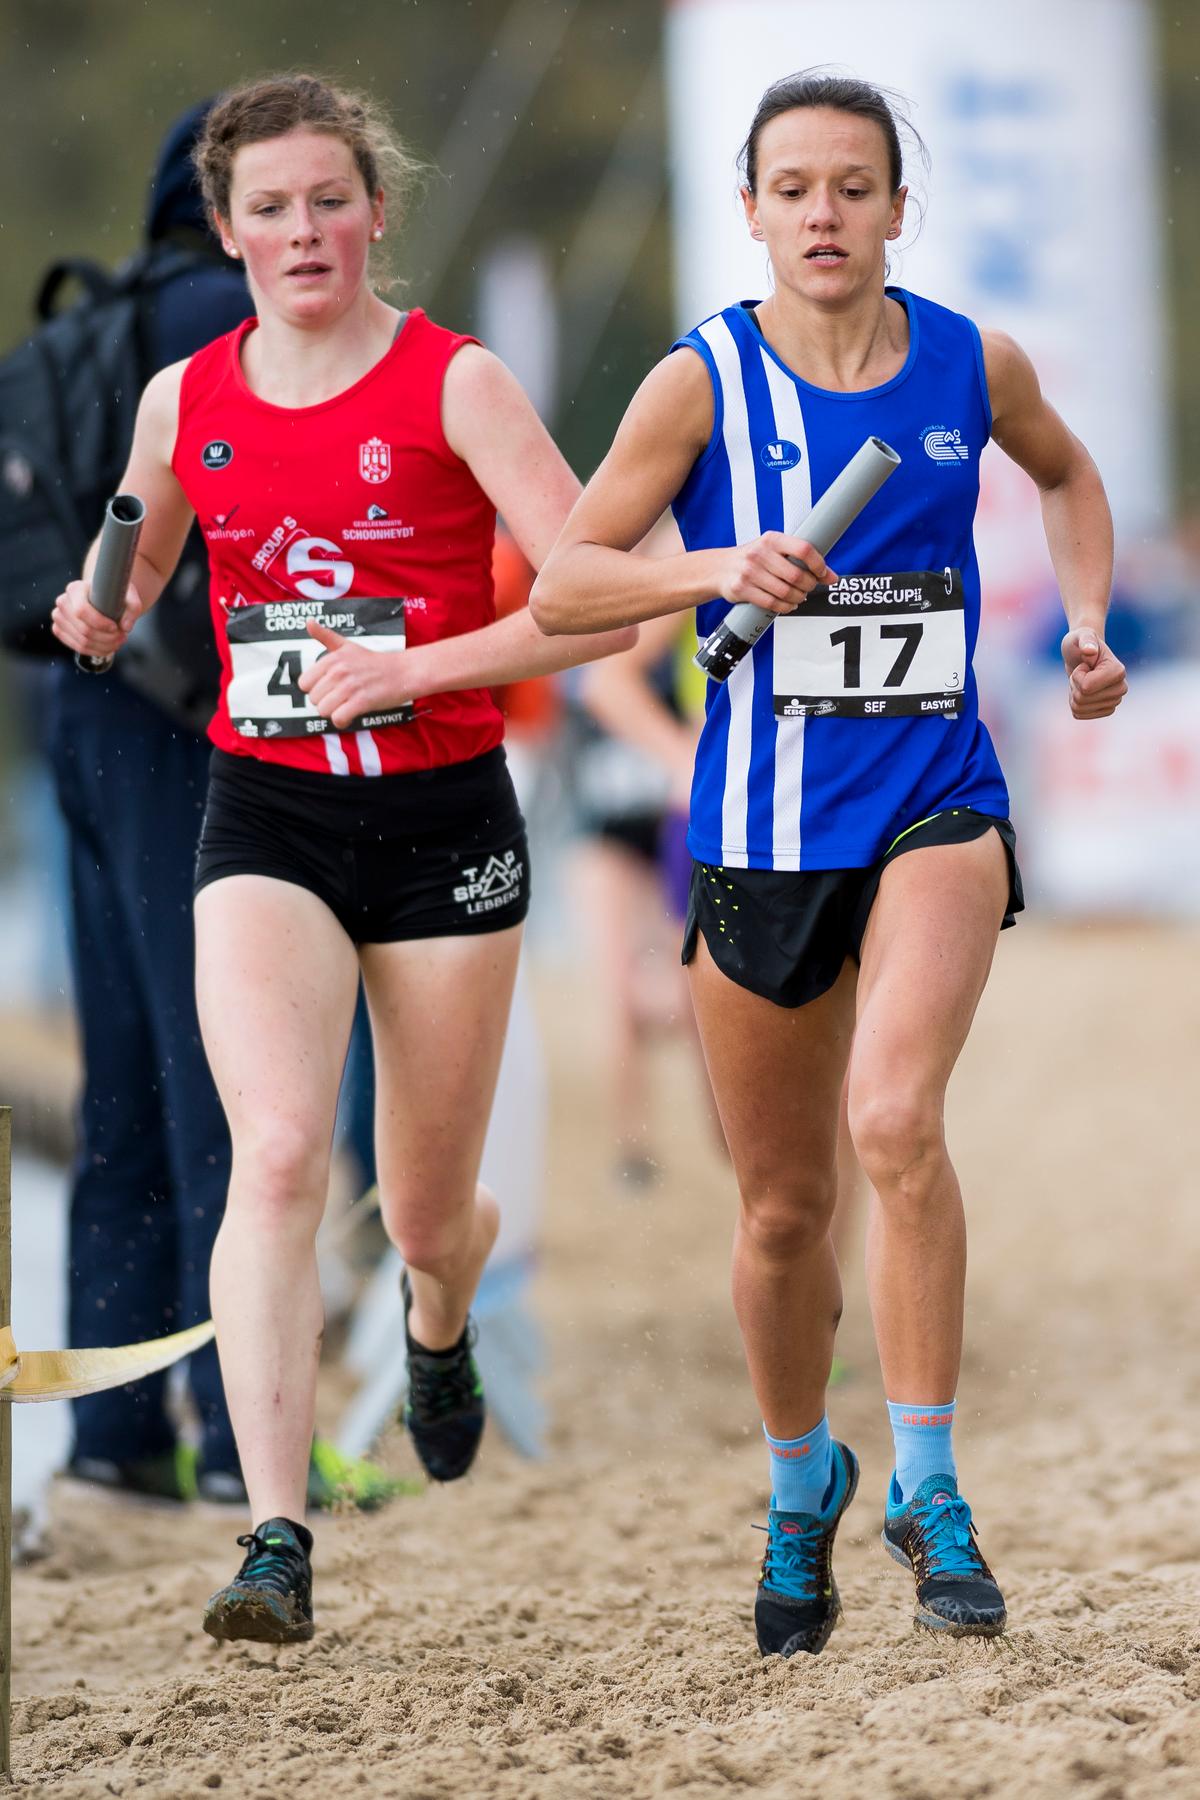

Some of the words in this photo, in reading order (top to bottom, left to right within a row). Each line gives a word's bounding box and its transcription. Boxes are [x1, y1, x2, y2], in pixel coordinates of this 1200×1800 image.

[342, 526, 415, 540] SCHOONHEYDT
[252, 526, 286, 571] GROUP
[283, 515, 298, 530] S
[828, 588, 915, 605] CROSSCUP
[829, 622, 924, 689] 17
[783, 708, 806, 716] KBC
[864, 701, 887, 714] SEF
[305, 720, 328, 733] SEF
[466, 884, 520, 915] LEBBEKE
